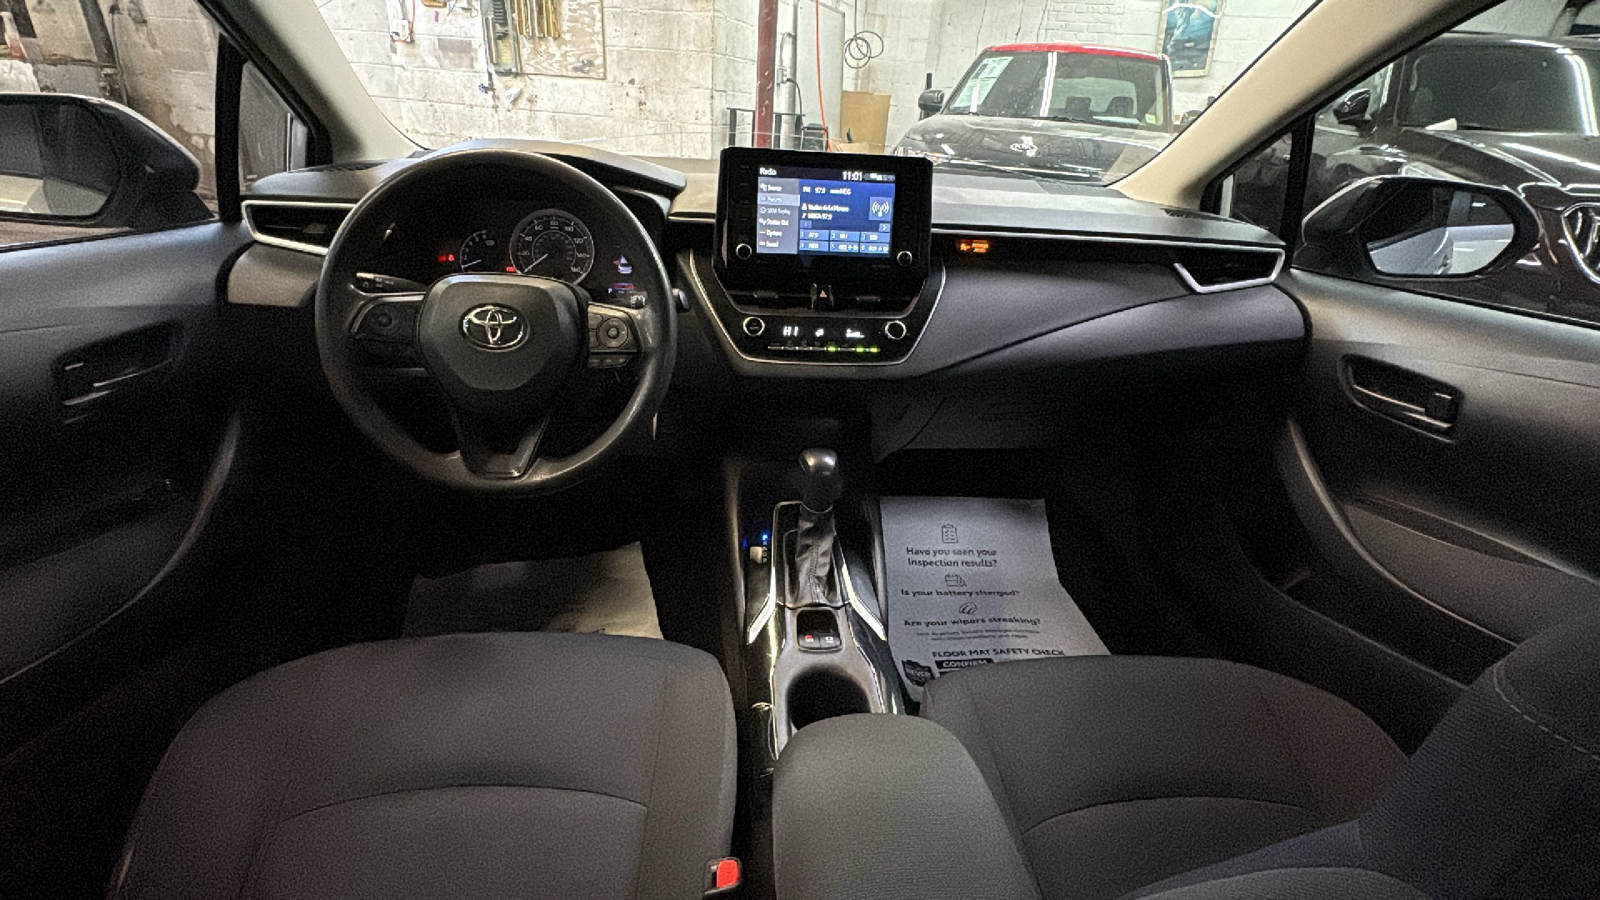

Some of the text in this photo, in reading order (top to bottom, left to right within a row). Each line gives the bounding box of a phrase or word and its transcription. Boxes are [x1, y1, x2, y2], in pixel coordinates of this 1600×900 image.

[760, 167, 777, 175] Radio
[842, 171, 862, 181] 11:01
[906, 547, 930, 556] Have
[932, 549, 950, 557] you
[976, 549, 997, 557] your
[961, 559, 998, 568] results?
[950, 618, 986, 626] wipers
[988, 616, 1041, 626] streaking?
